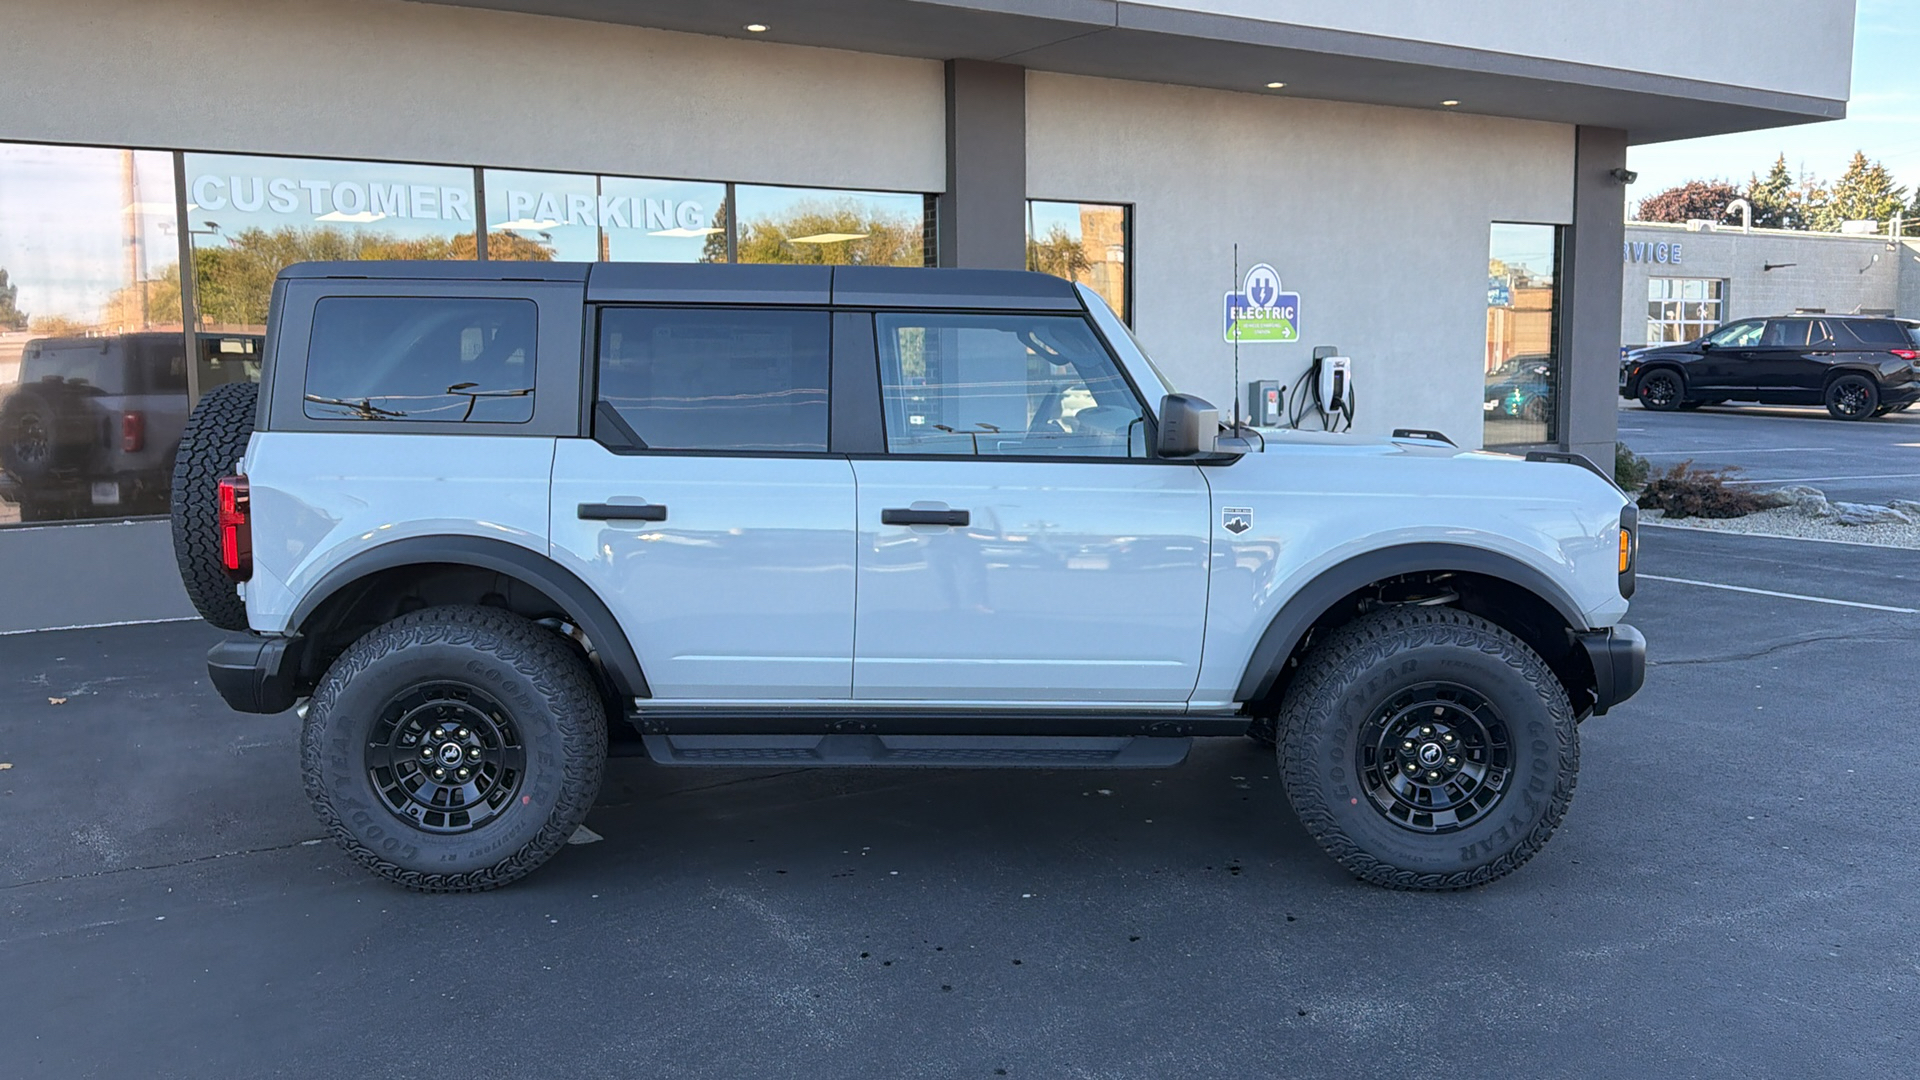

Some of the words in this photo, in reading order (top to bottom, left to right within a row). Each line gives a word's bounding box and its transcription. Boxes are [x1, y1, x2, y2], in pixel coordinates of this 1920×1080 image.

[192, 175, 471, 221] CUSTOMER
[507, 190, 704, 231] PARKING
[1230, 306, 1294, 320] ELECTRIC
[331, 715, 419, 860] GOODYEAR
[466, 659, 553, 806] GOODYEAR
[1329, 658, 1418, 798] GOODYEAR
[1460, 720, 1549, 862] GOODYEAR
